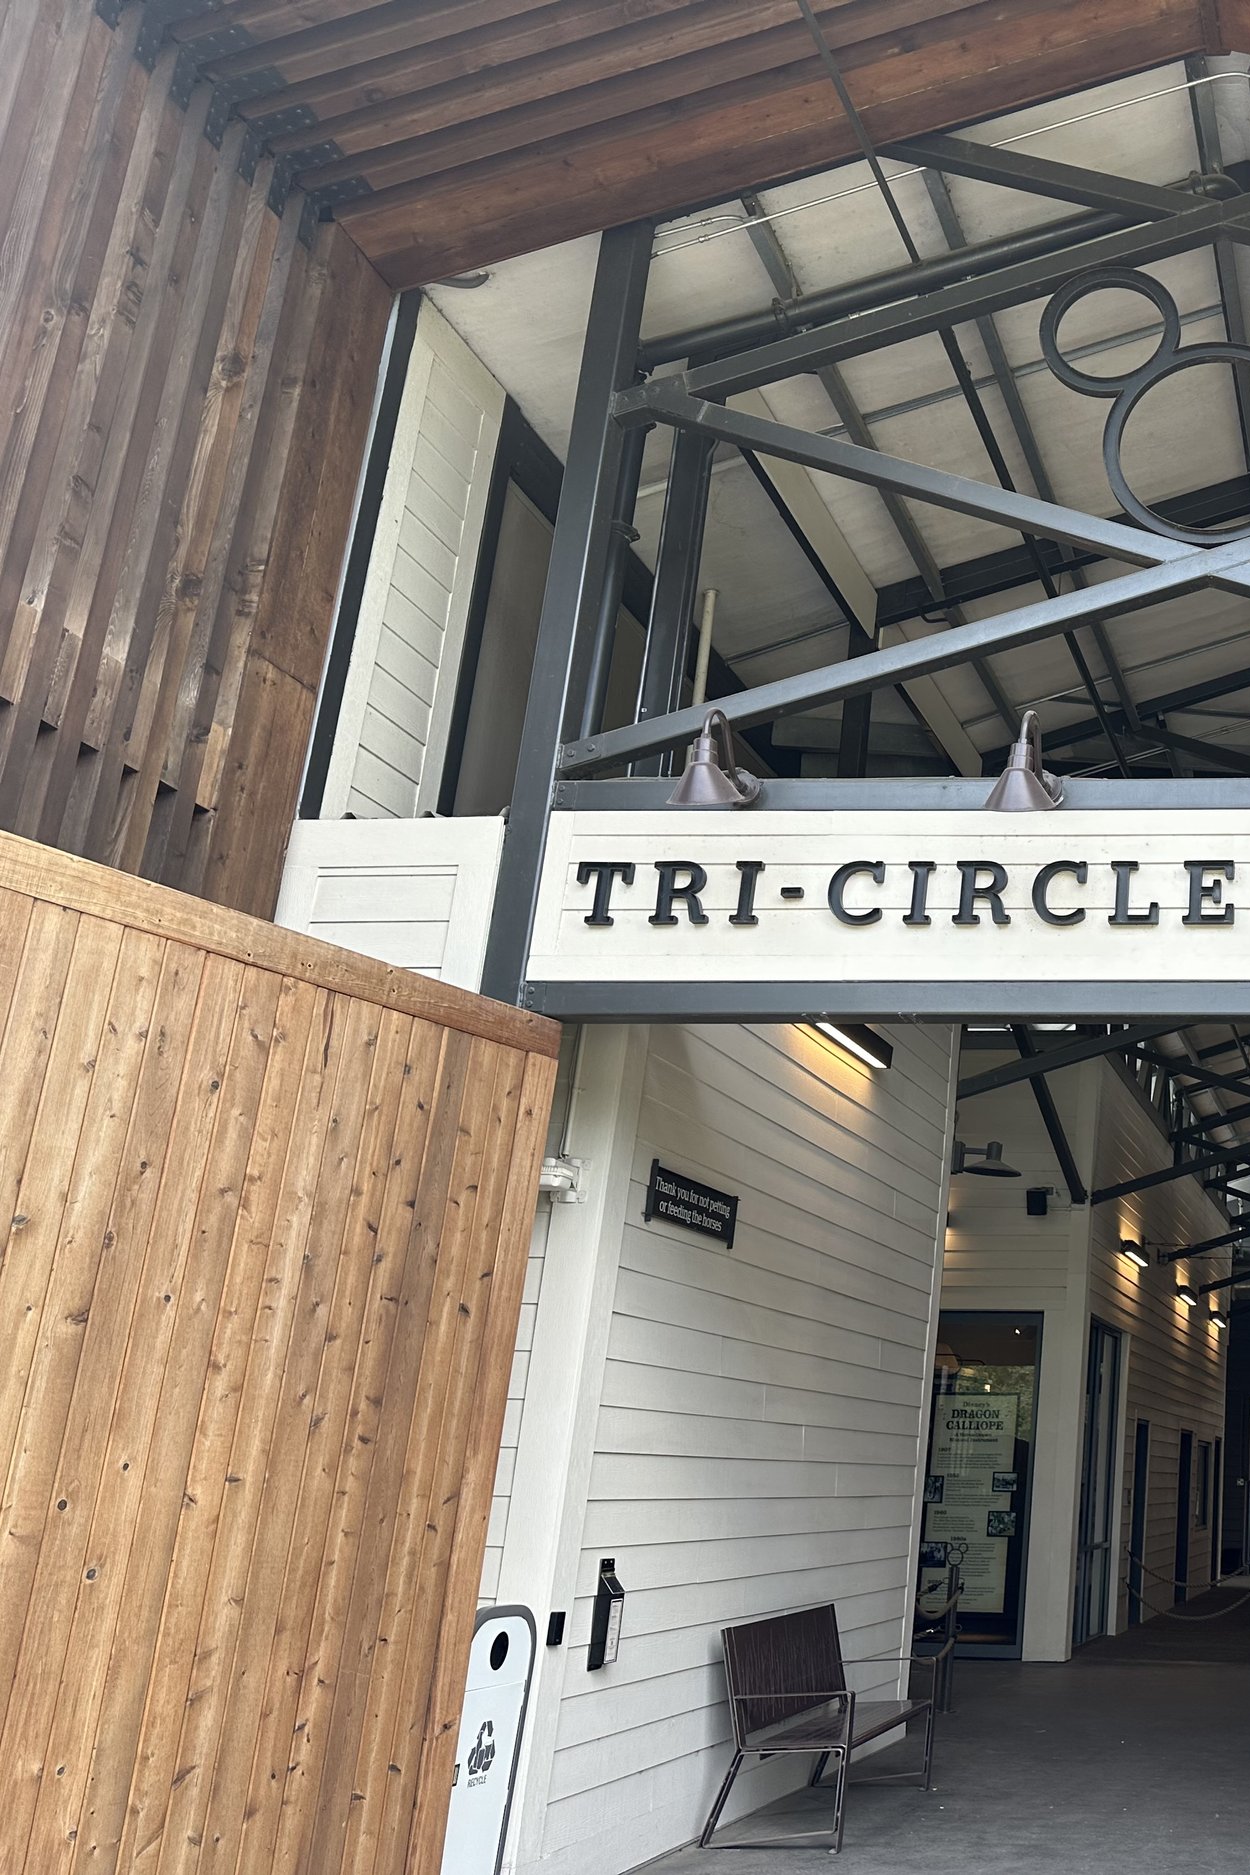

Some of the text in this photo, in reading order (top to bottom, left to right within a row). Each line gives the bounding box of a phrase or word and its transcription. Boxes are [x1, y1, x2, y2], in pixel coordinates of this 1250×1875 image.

[655, 1176, 731, 1219] Thank you for not petting
[659, 1200, 722, 1232] or feeding the horses
[963, 1401, 990, 1409] Disney's
[951, 1409, 1000, 1419] DRAGON
[946, 1420, 1004, 1431] CALLIOPE
[467, 1774, 487, 1788] RECYCLE
